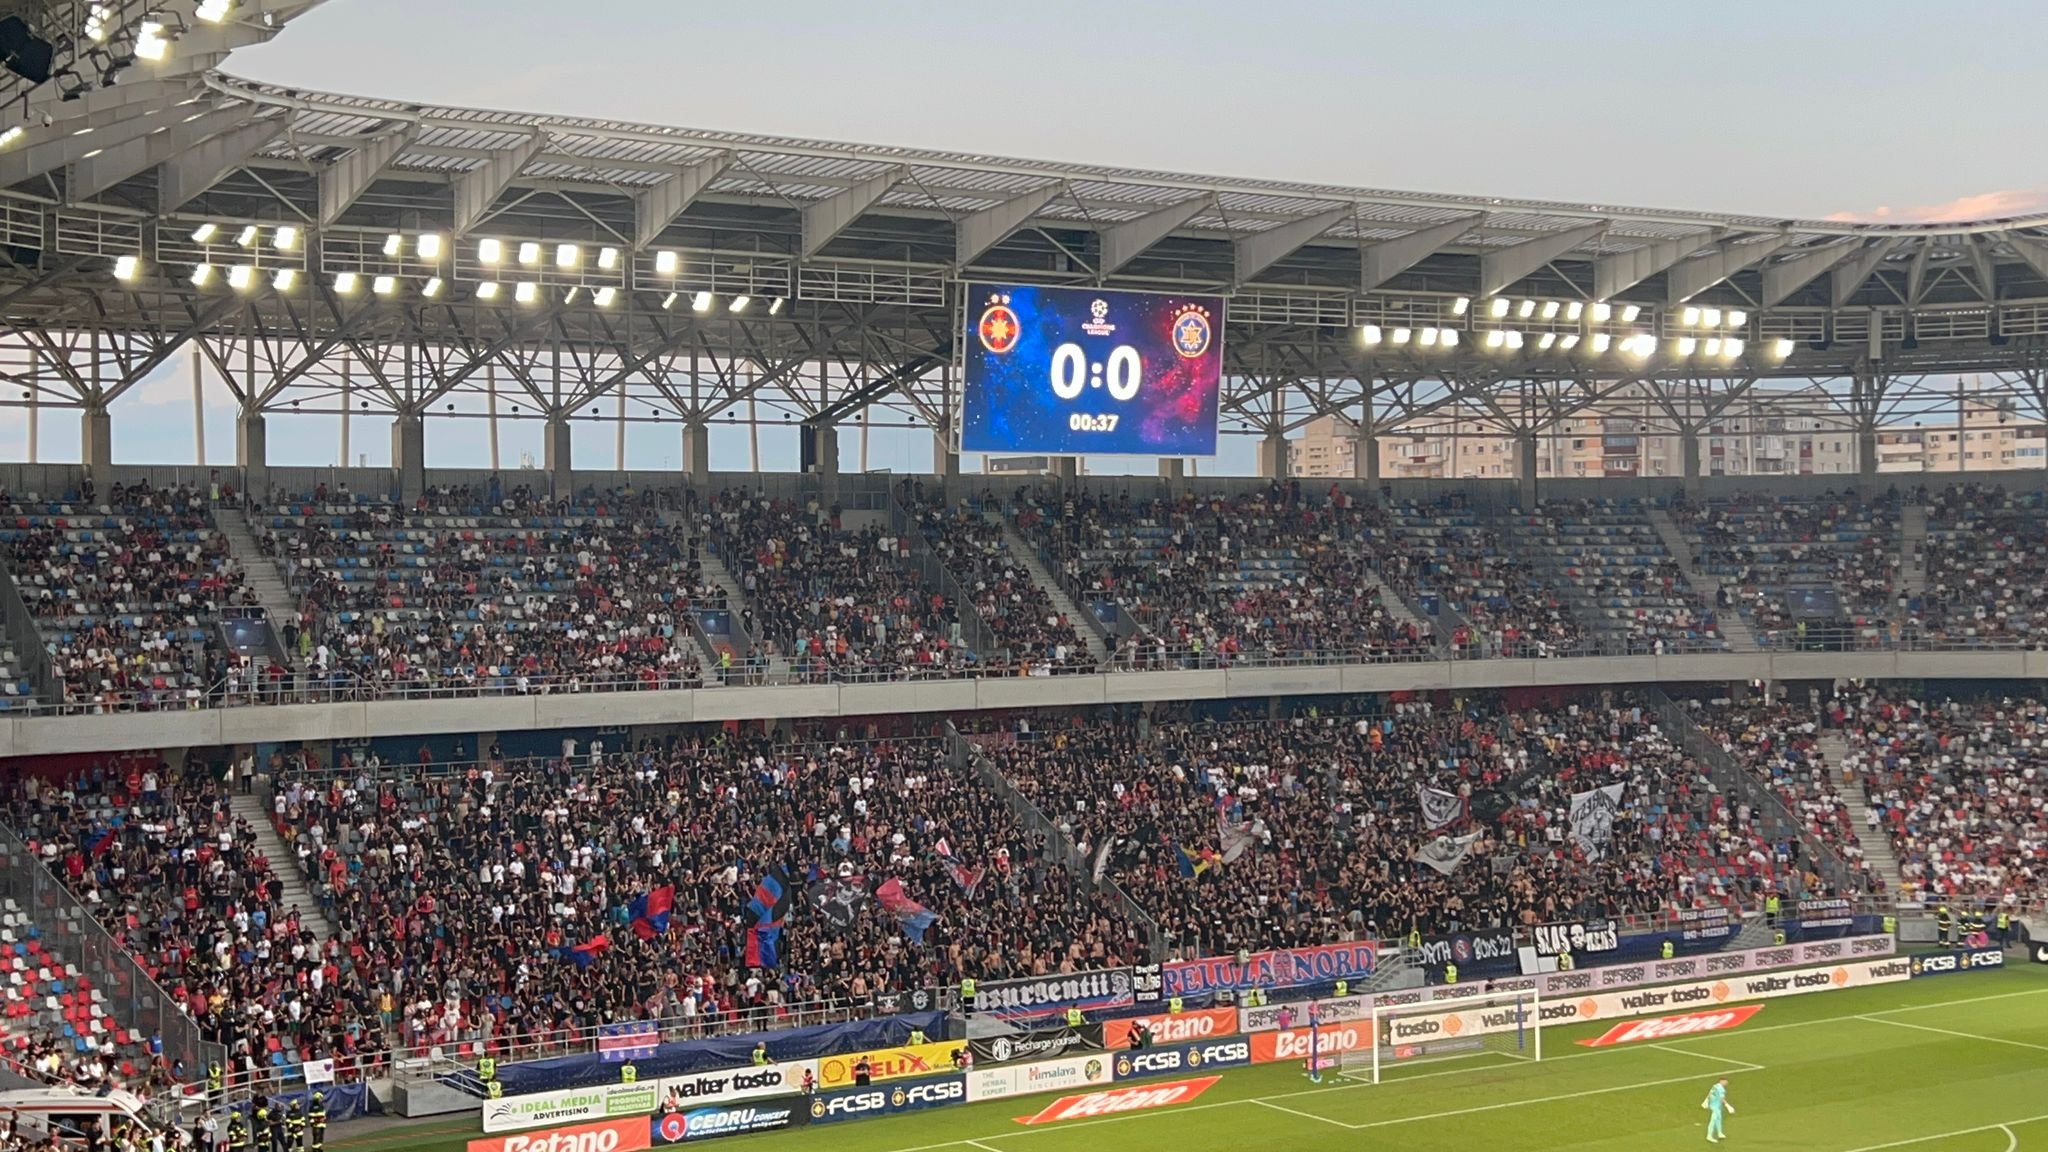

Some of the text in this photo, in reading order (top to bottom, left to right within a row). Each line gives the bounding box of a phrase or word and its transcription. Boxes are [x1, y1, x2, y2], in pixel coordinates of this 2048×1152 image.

[1051, 343, 1141, 400] 0:0
[1069, 414, 1119, 432] 00:37
[1295, 947, 1374, 981] NORD
[1923, 956, 1956, 971] FCSB
[1971, 951, 2003, 966] FCSB
[973, 973, 1109, 1010] nsurgentii
[1747, 972, 1830, 993] walter tosto
[1621, 987, 1710, 1009] walter tosto
[1396, 1020, 1440, 1037] tosto
[1014, 1039, 1052, 1052] Recharge
[1052, 1034, 1081, 1047] yourself
[1202, 1043, 1249, 1063] FCSB
[1132, 1051, 1181, 1072] FCSB
[732, 1069, 782, 1091] tosto
[1029, 1066, 1076, 1081] Himalaya
[906, 1081, 963, 1104] FCSB
[1056, 1086, 1188, 1120] Betano
[521, 1094, 601, 1114] IDEAL MEDIA
[533, 1106, 589, 1121] ADVERTISING
[826, 1092, 885, 1115] FCSB
[689, 1108, 791, 1131] CEDRU CONCEPT
[503, 1128, 618, 1152] Betano
